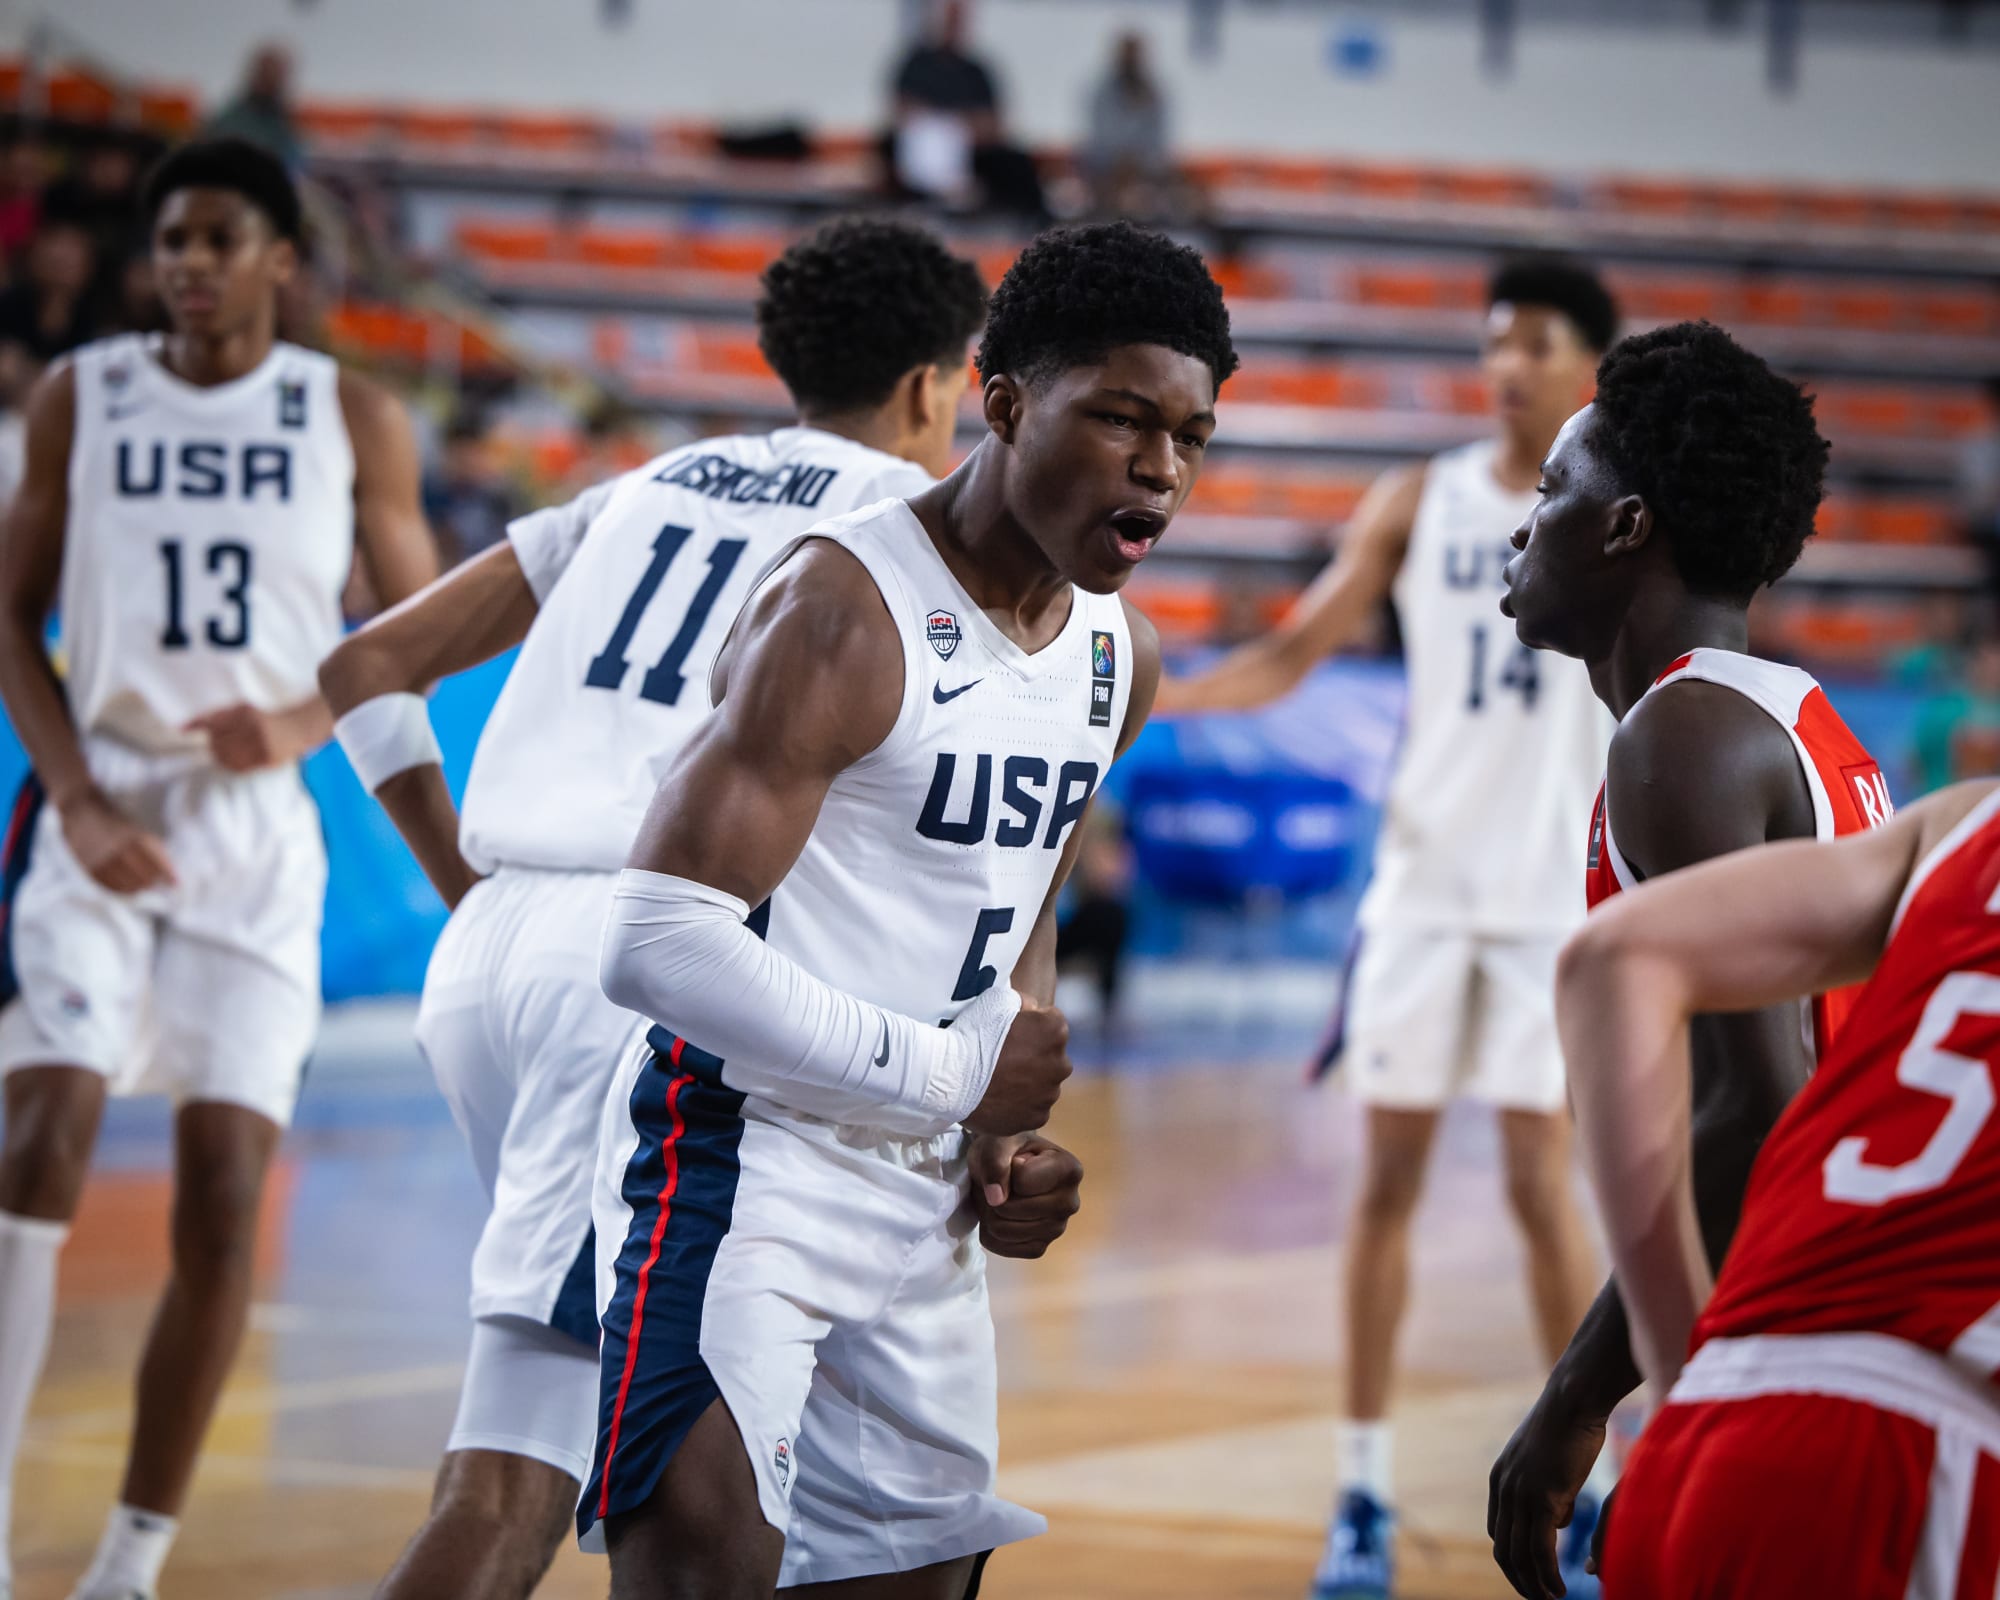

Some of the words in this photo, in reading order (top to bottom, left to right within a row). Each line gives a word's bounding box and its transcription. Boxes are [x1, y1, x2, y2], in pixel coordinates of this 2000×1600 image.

[116, 438, 291, 503] USA
[160, 539, 251, 651] 13
[583, 523, 749, 707] 11
[1094, 685, 1109, 702] FIBA
[1468, 623, 1540, 712] 14
[915, 752, 1100, 850] USA
[1822, 970, 2000, 1208] 5
